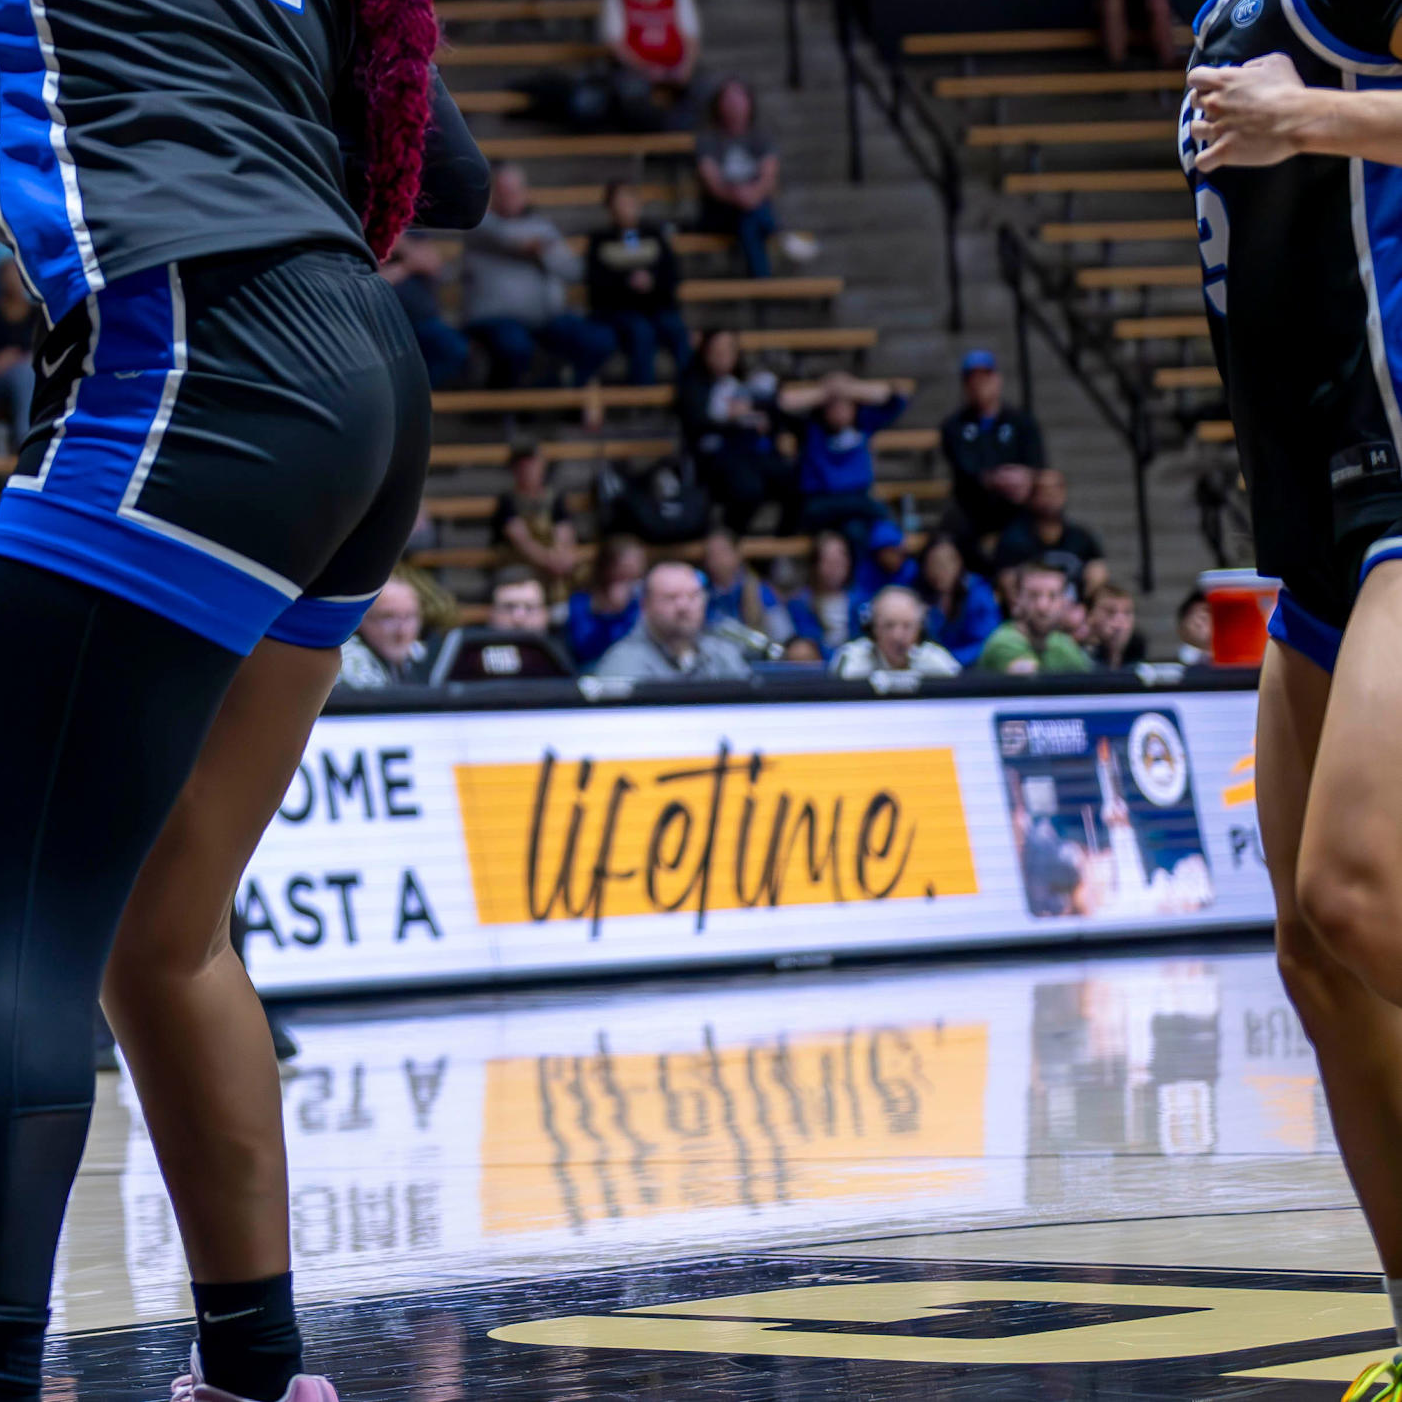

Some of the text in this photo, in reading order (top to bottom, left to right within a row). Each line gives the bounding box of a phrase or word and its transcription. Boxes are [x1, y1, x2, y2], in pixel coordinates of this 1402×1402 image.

[279, 746, 422, 826] OME
[241, 866, 443, 948] AST A
